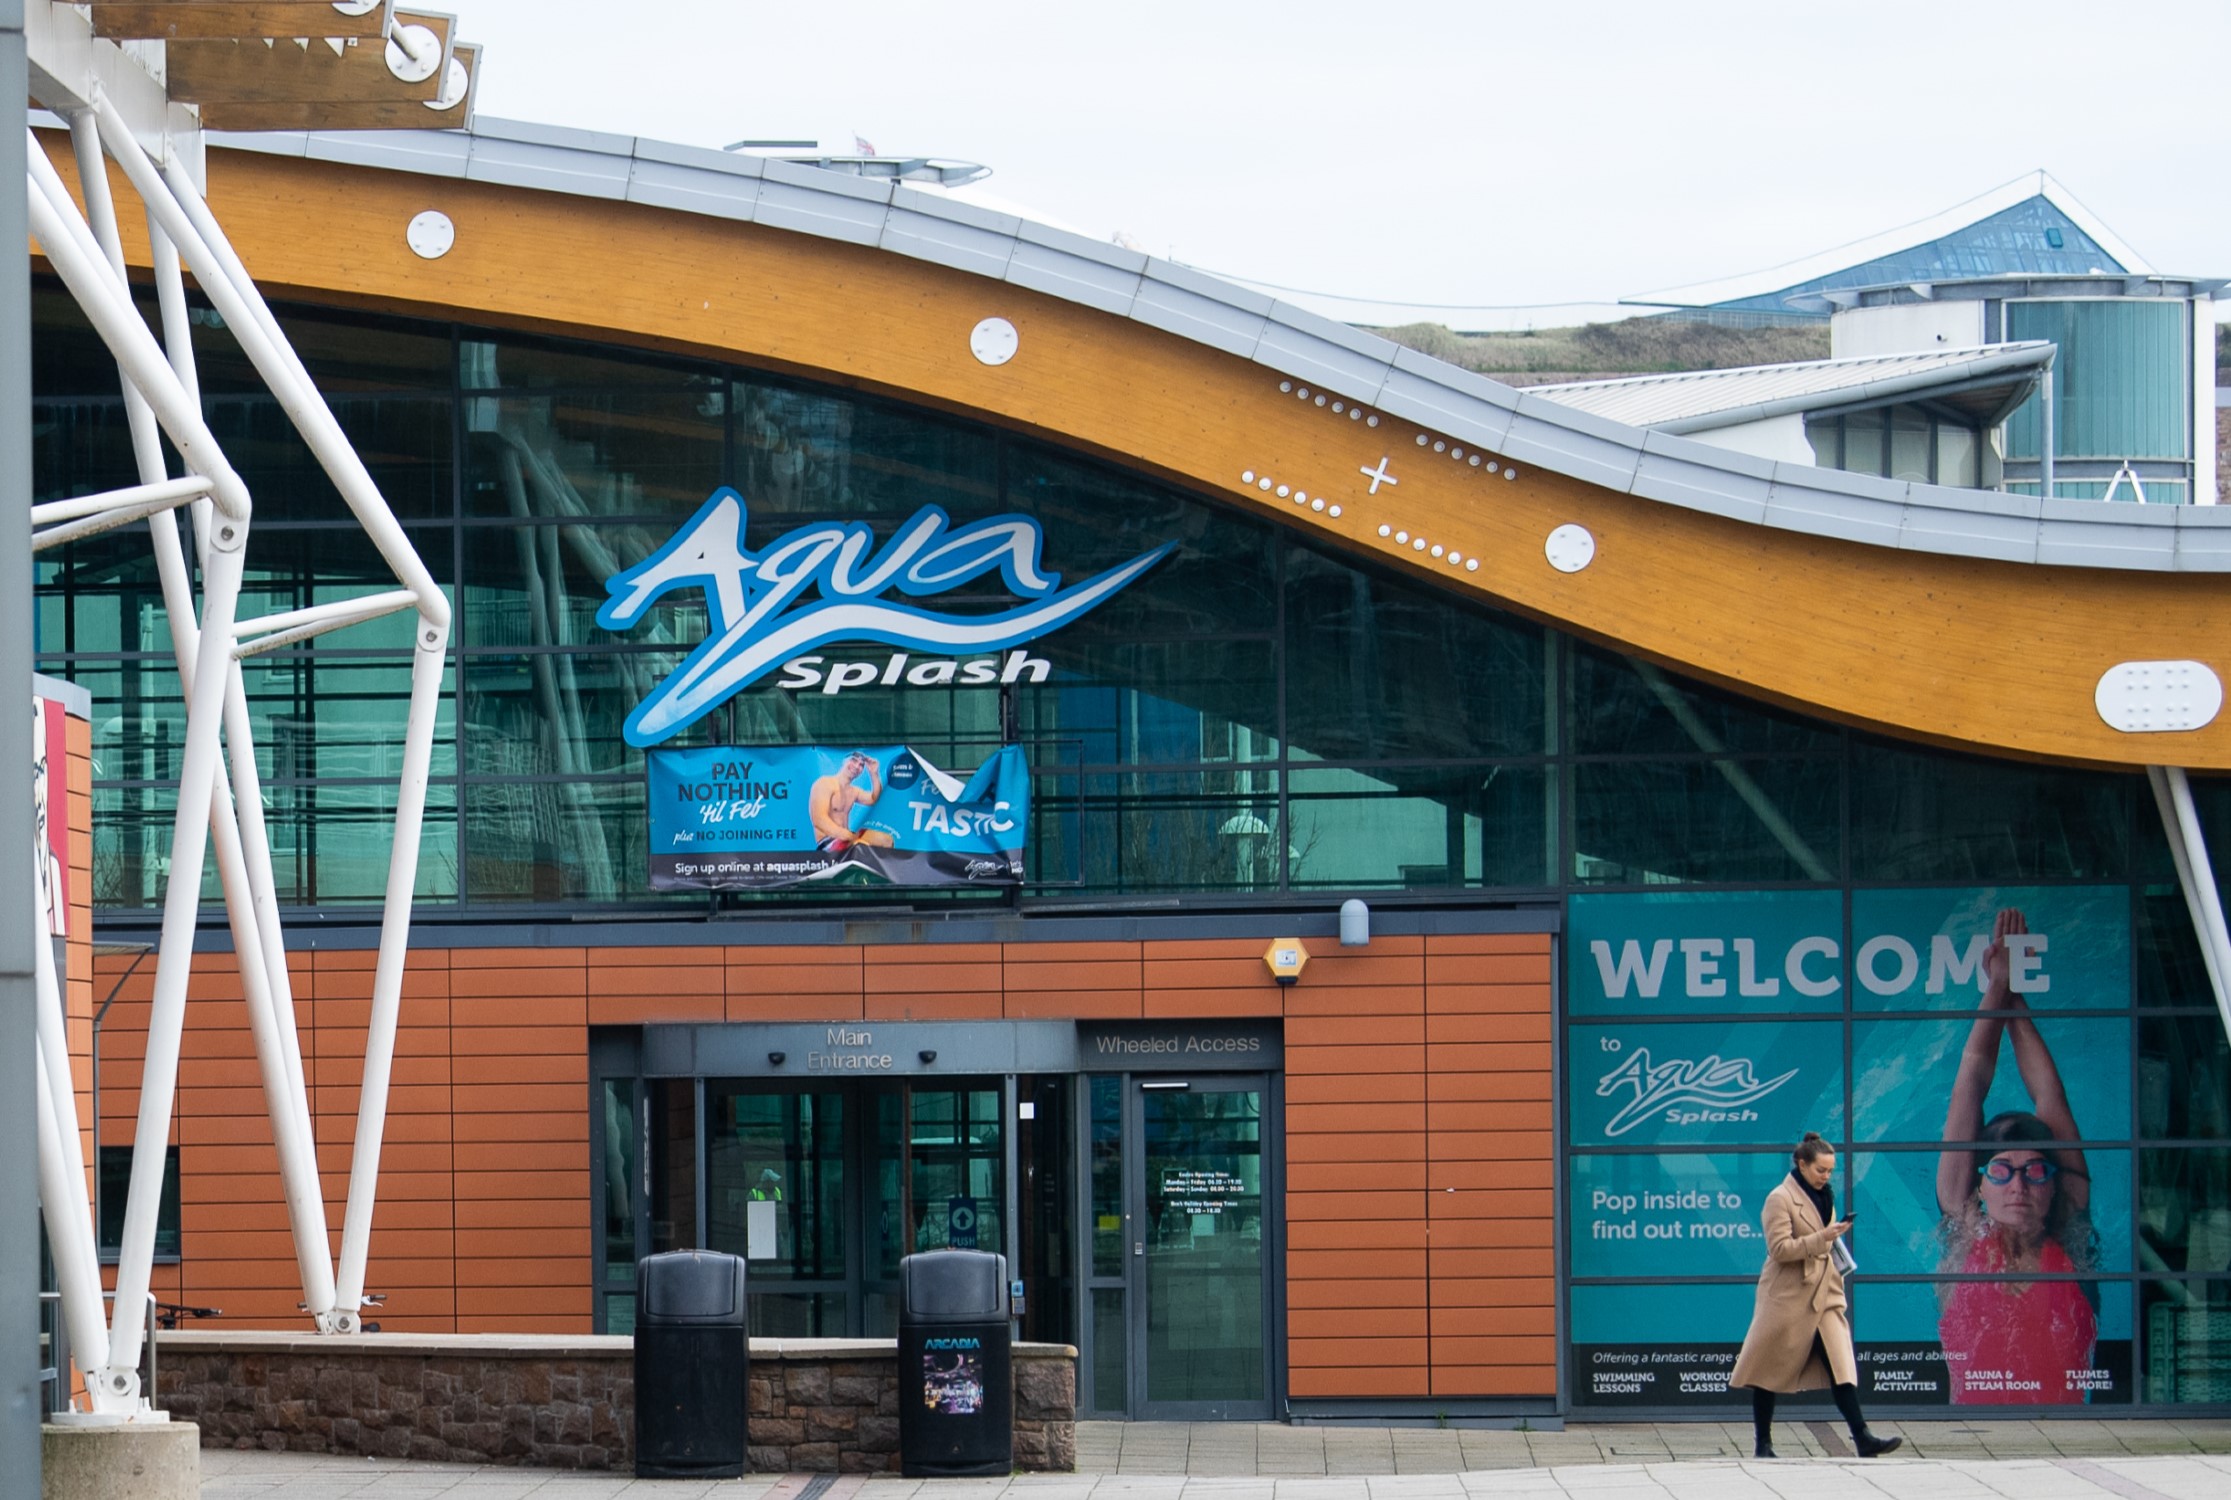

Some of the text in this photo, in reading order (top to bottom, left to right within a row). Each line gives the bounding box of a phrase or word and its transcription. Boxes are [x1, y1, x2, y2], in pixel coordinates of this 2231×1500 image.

[712, 762, 753, 780] PAY
[729, 795, 766, 820] Feb
[696, 831, 716, 841] NO
[719, 829, 773, 840] JOINING
[776, 829, 797, 839] FEE
[675, 863, 698, 876] Sign
[700, 864, 715, 875] up
[717, 861, 751, 872] online
[753, 862, 765, 871] at
[1590, 933, 2051, 998] WELCOME
[827, 1028, 872, 1046] Main
[1097, 1035, 1260, 1053] Wheeled Access
[1600, 1037, 1621, 1051] to
[808, 1051, 892, 1069] Entrance
[1665, 1109, 1758, 1125] Splash
[1592, 1190, 1741, 1214] Pop inside to
[1592, 1220, 1636, 1239] find
[1643, 1221, 1682, 1239] out
[952, 1236, 976, 1247] PUSH
[925, 1338, 980, 1349] ARCADIA
[1593, 1352, 1639, 1365] Offering
[1650, 1352, 1698, 1364] fantastic
[1700, 1354, 1733, 1364] range
[1857, 1351, 1968, 1362] all ages and abilities
[1593, 1373, 1655, 1382] SWIMMING
[1679, 1372, 1734, 1382] WORKOU
[1873, 1371, 1914, 1380] FAMILY
[1965, 1371, 2013, 1380] SAUNA &
[2066, 1370, 2110, 1379] FLUMES
[1593, 1383, 1641, 1393] LESSONS
[1679, 1383, 1727, 1392] CLASSES
[1873, 1381, 1937, 1391] ACTIVITIES
[1965, 1381, 2041, 1391] STEAM ROOM
[2066, 1380, 2113, 1390] & MORE!
